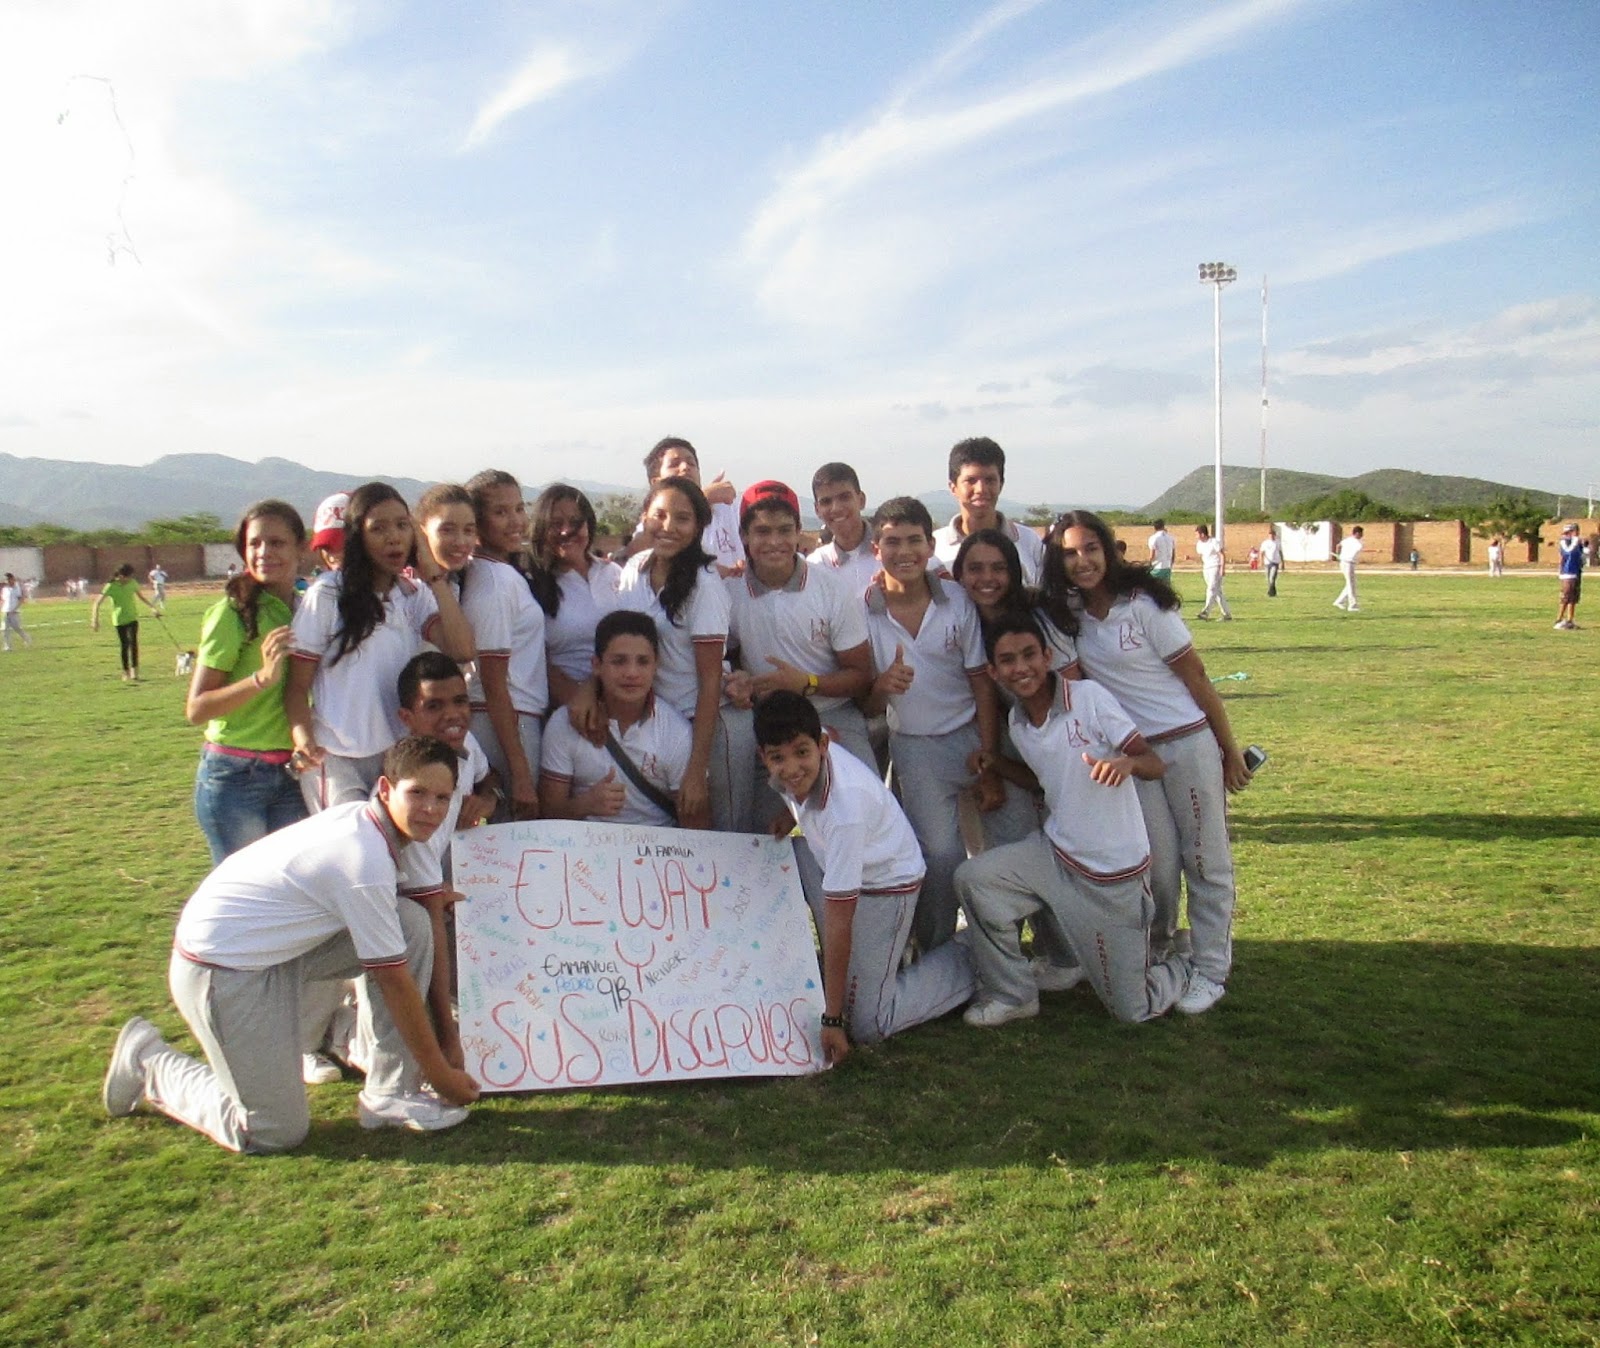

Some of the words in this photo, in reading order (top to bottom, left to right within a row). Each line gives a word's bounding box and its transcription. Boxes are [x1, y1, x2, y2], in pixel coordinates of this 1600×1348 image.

[636, 844, 652, 858] LA
[656, 844, 695, 859] FAMILIA
[508, 849, 605, 930] EL
[617, 857, 718, 930] WAY
[541, 953, 621, 978] EMMANUEL
[613, 938, 656, 994] Y
[597, 975, 632, 1013] 9B
[480, 993, 603, 1088] SUS
